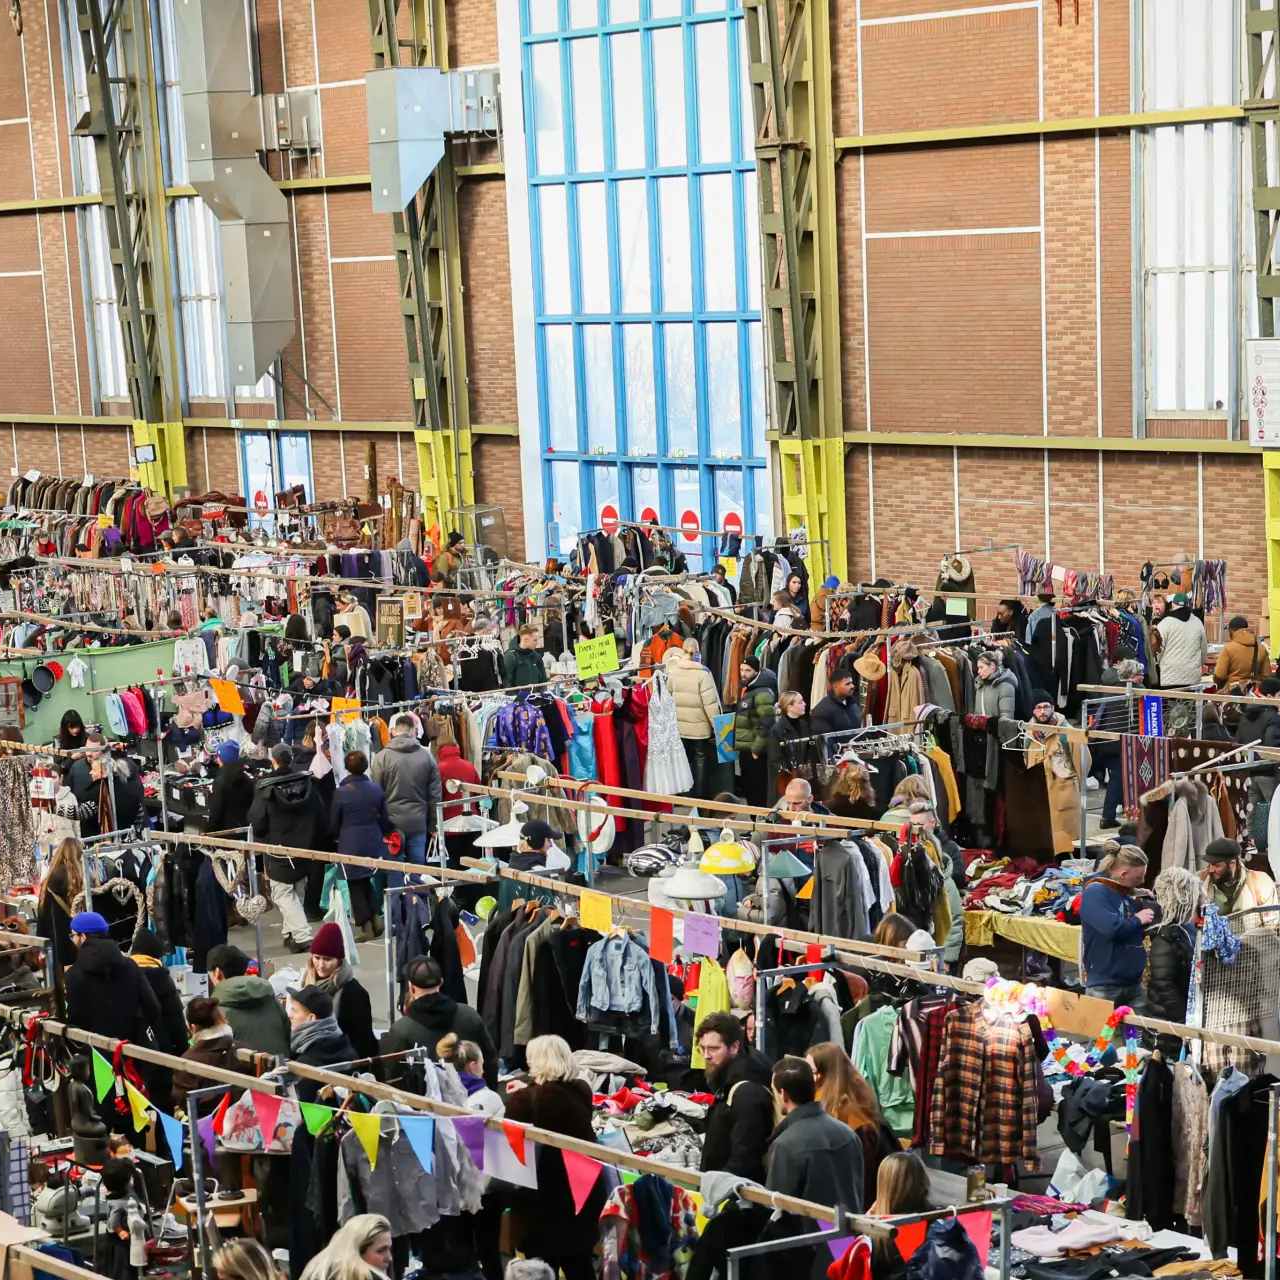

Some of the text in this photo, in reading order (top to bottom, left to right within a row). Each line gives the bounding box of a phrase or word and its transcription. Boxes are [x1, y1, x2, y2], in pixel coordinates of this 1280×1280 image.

[381, 603, 401, 615] VINTAGE
[380, 615, 401, 625] MEUBELS
[1150, 701, 1159, 736] FRANKRI
